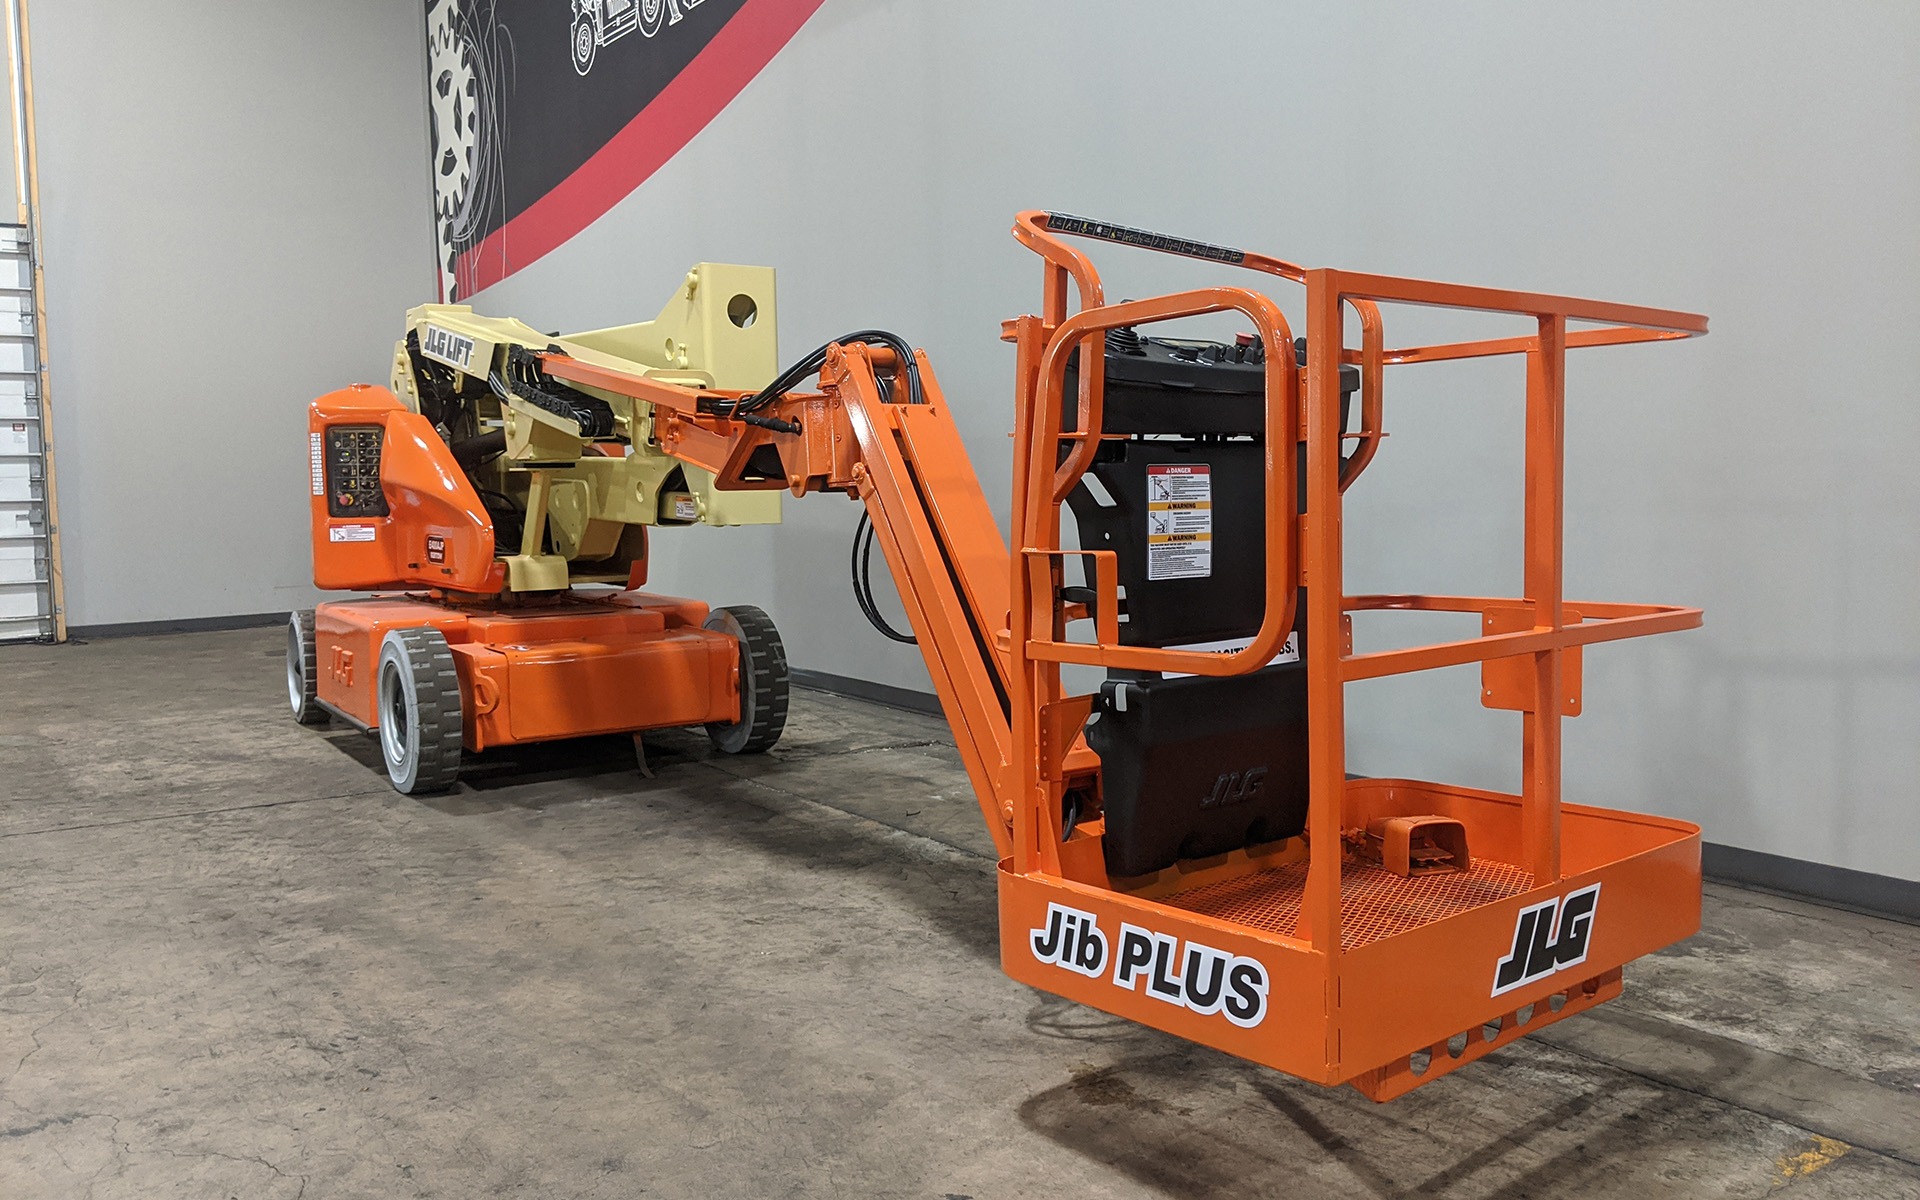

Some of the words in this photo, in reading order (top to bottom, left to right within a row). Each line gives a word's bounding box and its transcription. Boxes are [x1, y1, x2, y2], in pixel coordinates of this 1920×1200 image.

[424, 327, 446, 356] JLG
[446, 334, 473, 366] LIFT
[1278, 640, 1295, 655] BS.
[1200, 766, 1268, 806] JLG
[1496, 889, 1597, 990] JLG
[1034, 910, 1103, 971] Jib
[1119, 931, 1263, 1020] PLUS
